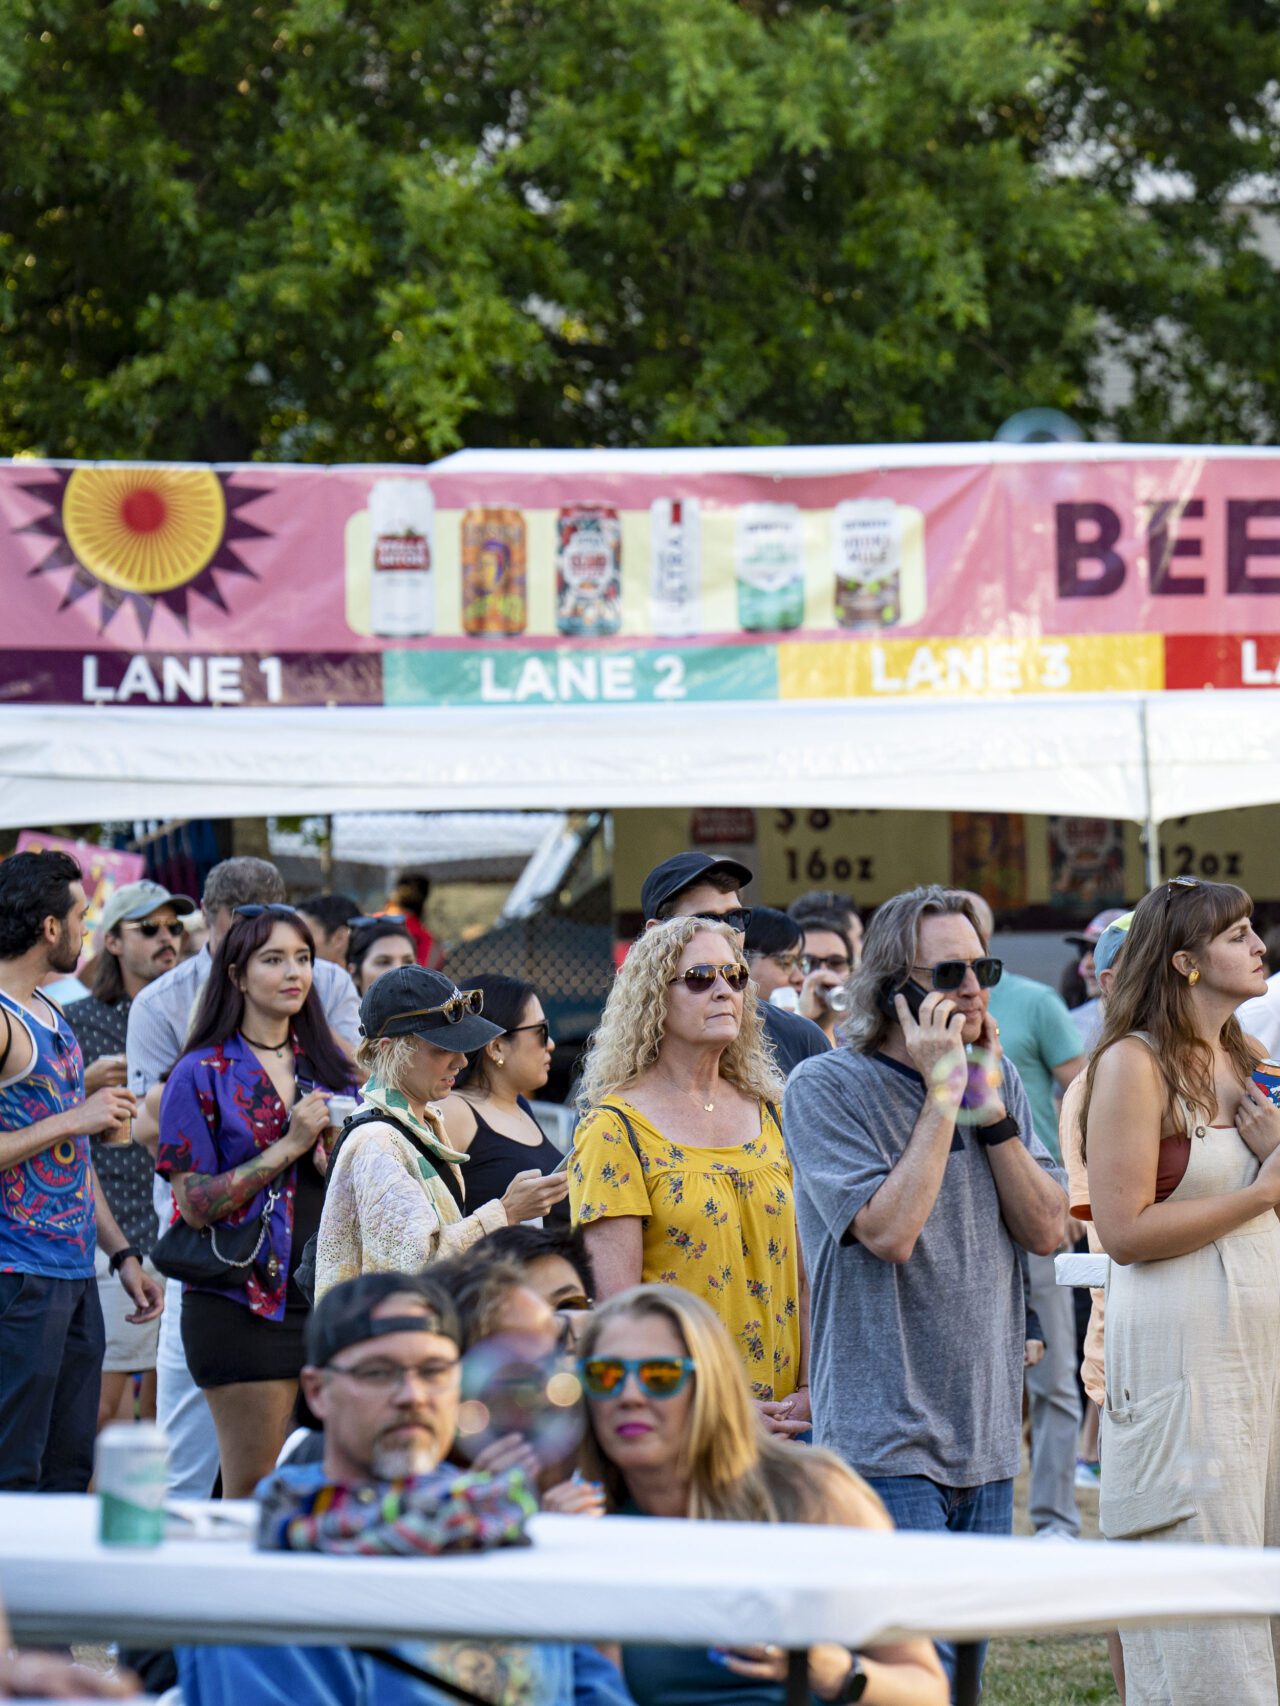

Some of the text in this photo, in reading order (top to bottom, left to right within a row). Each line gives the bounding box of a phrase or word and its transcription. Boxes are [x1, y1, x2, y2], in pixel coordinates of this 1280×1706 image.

[82, 656, 283, 701] LANE 1
[480, 655, 687, 701] LANE 2
[870, 643, 1071, 691] LANE 3
[786, 847, 875, 882] 16oz
